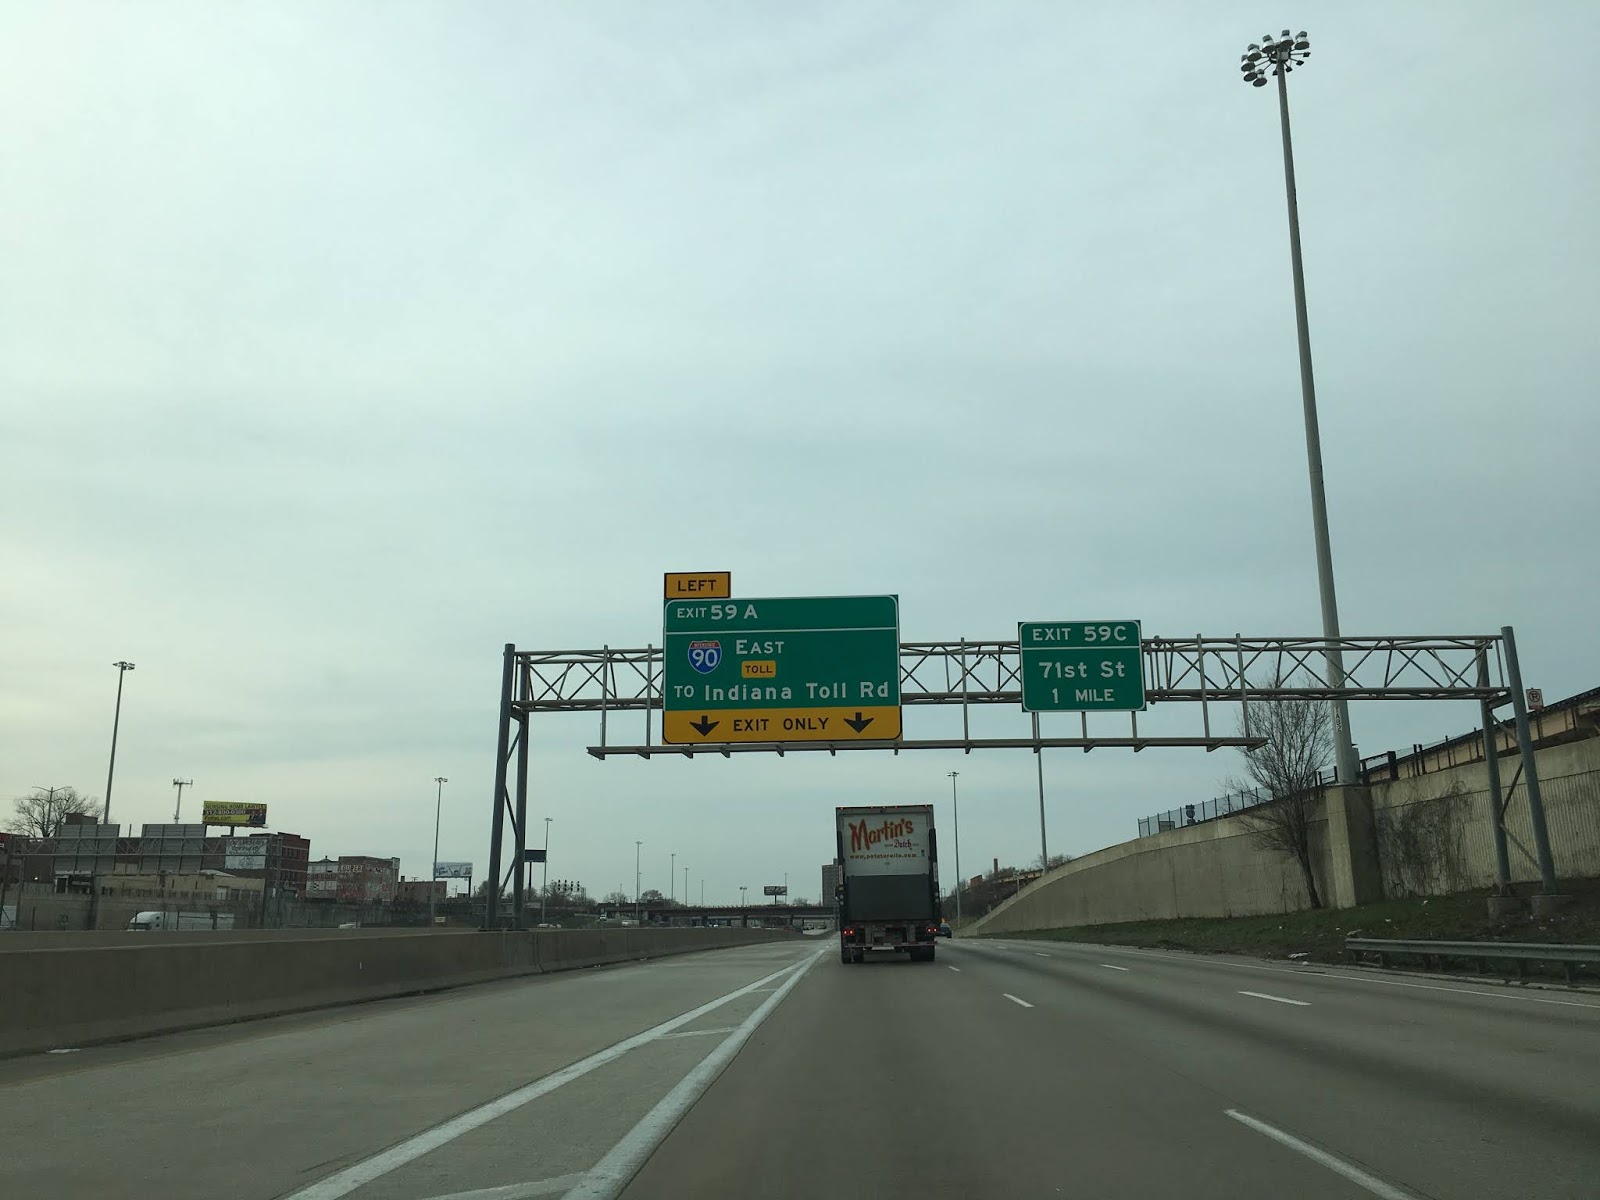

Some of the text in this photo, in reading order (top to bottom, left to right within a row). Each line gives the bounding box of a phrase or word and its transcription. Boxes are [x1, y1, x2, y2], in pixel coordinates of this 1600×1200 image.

[678, 579, 717, 592] LEFT
[677, 604, 758, 620] EXIT 59 A
[1032, 625, 1127, 642] EXIT 59C
[736, 639, 785, 655] EAST
[692, 648, 718, 667] 90
[745, 665, 773, 673] TOLL
[1038, 660, 1125, 679] 71st St
[674, 681, 888, 701] TO Indiana Toll Rd
[1052, 688, 1115, 704] 1 MILE
[733, 717, 829, 731] EXIT ONLY
[848, 818, 914, 853] Martin's
[894, 838, 912, 849] Dutch
